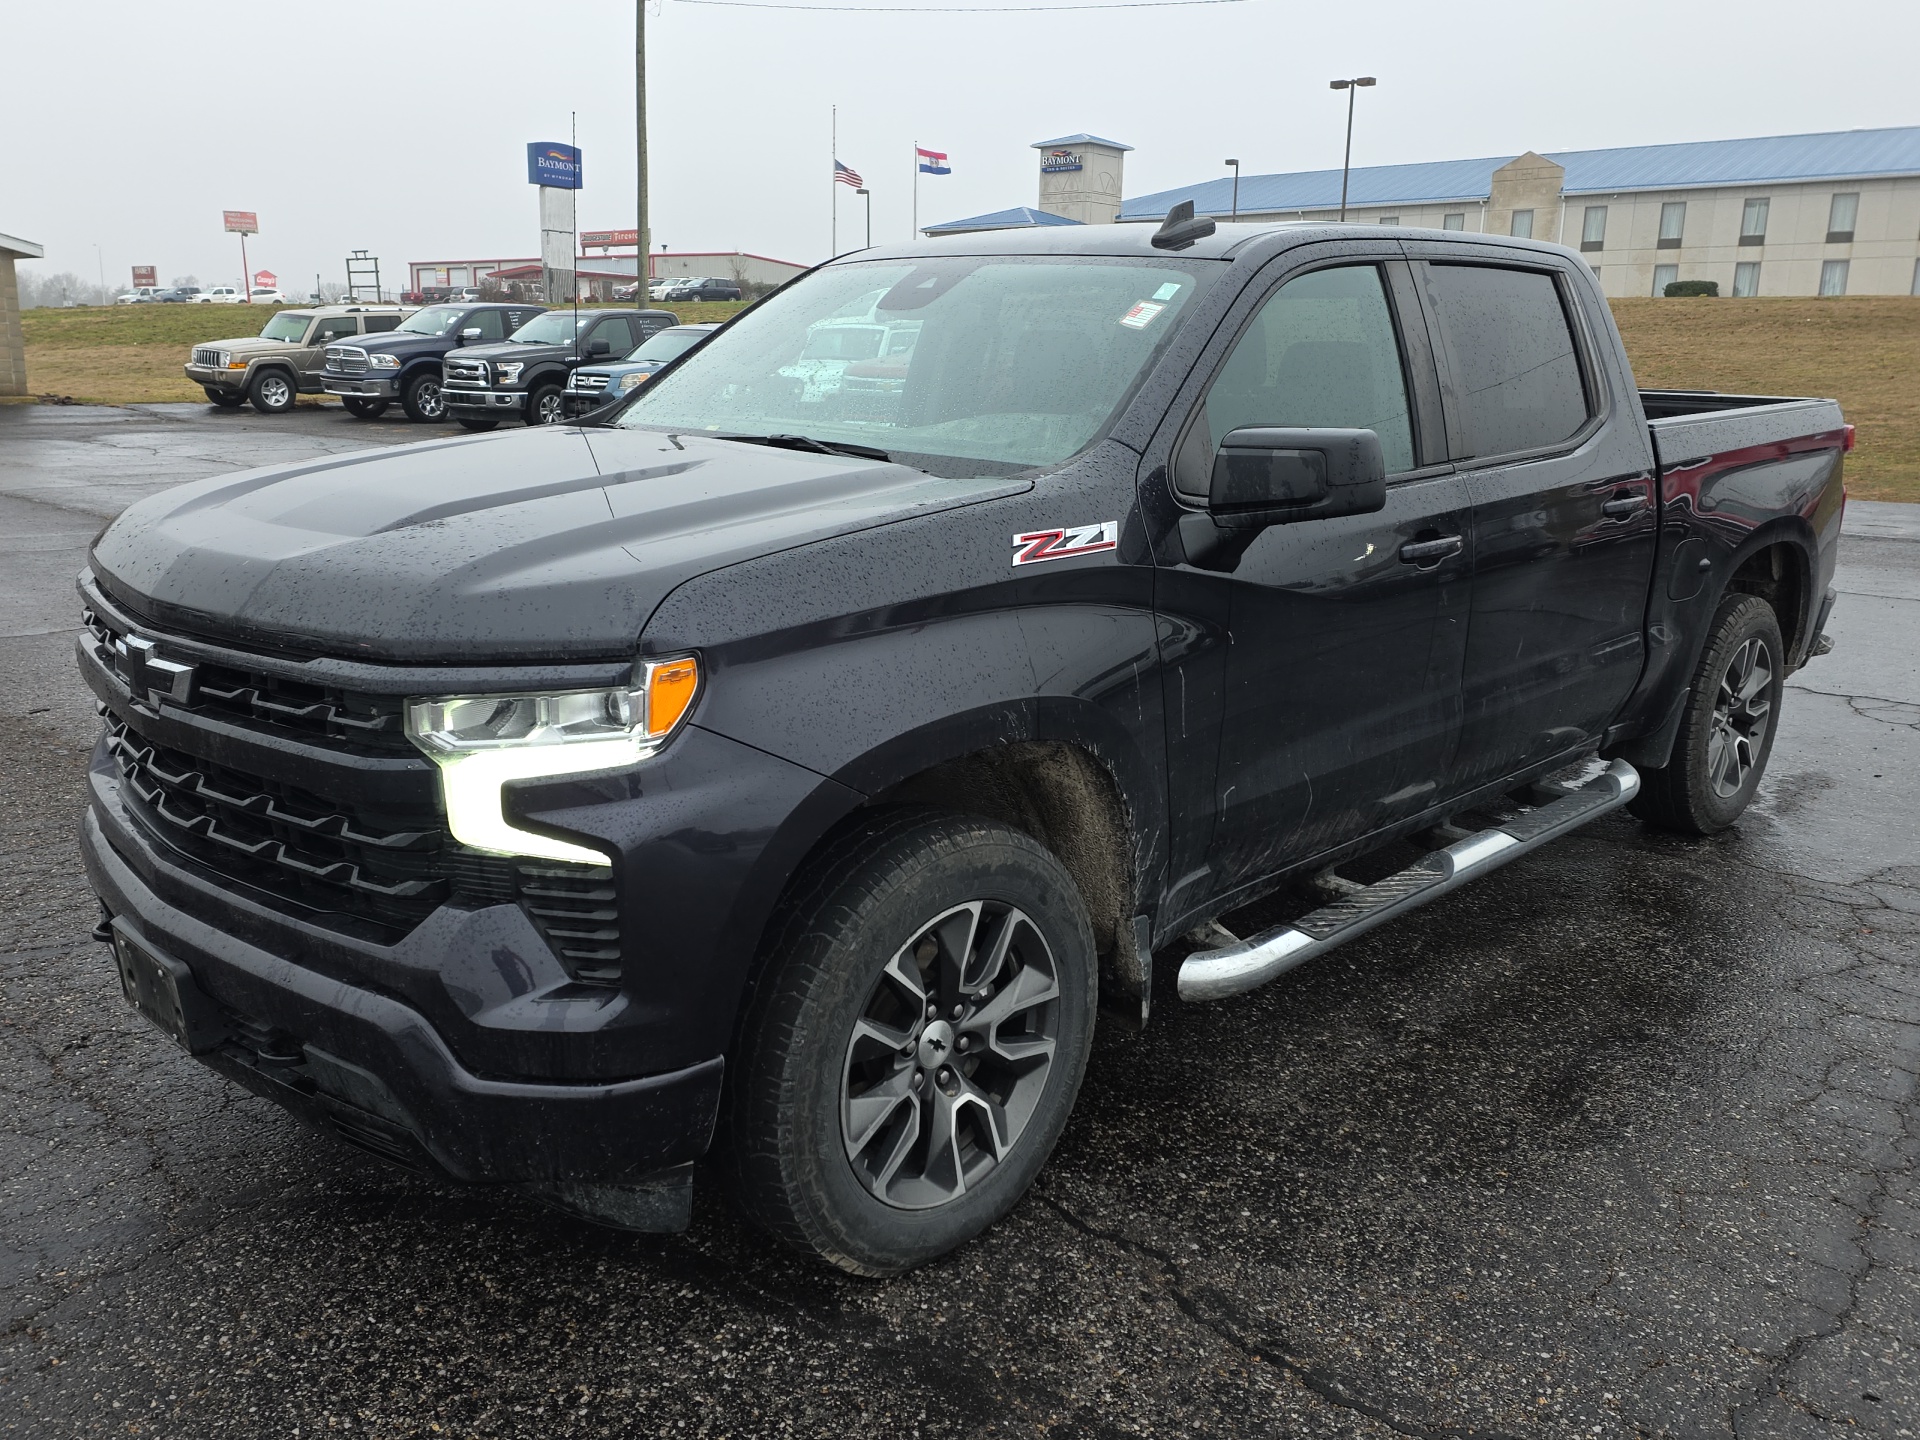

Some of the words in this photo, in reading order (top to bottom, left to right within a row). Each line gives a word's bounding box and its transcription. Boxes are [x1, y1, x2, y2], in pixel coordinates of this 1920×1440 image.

[538, 157, 580, 172] BAYMONT
[1042, 155, 1080, 165] BAYMONT
[134, 266, 151, 275] HANEY
[256, 275, 275, 285] Casey's
[1011, 520, 1118, 567] Z71
